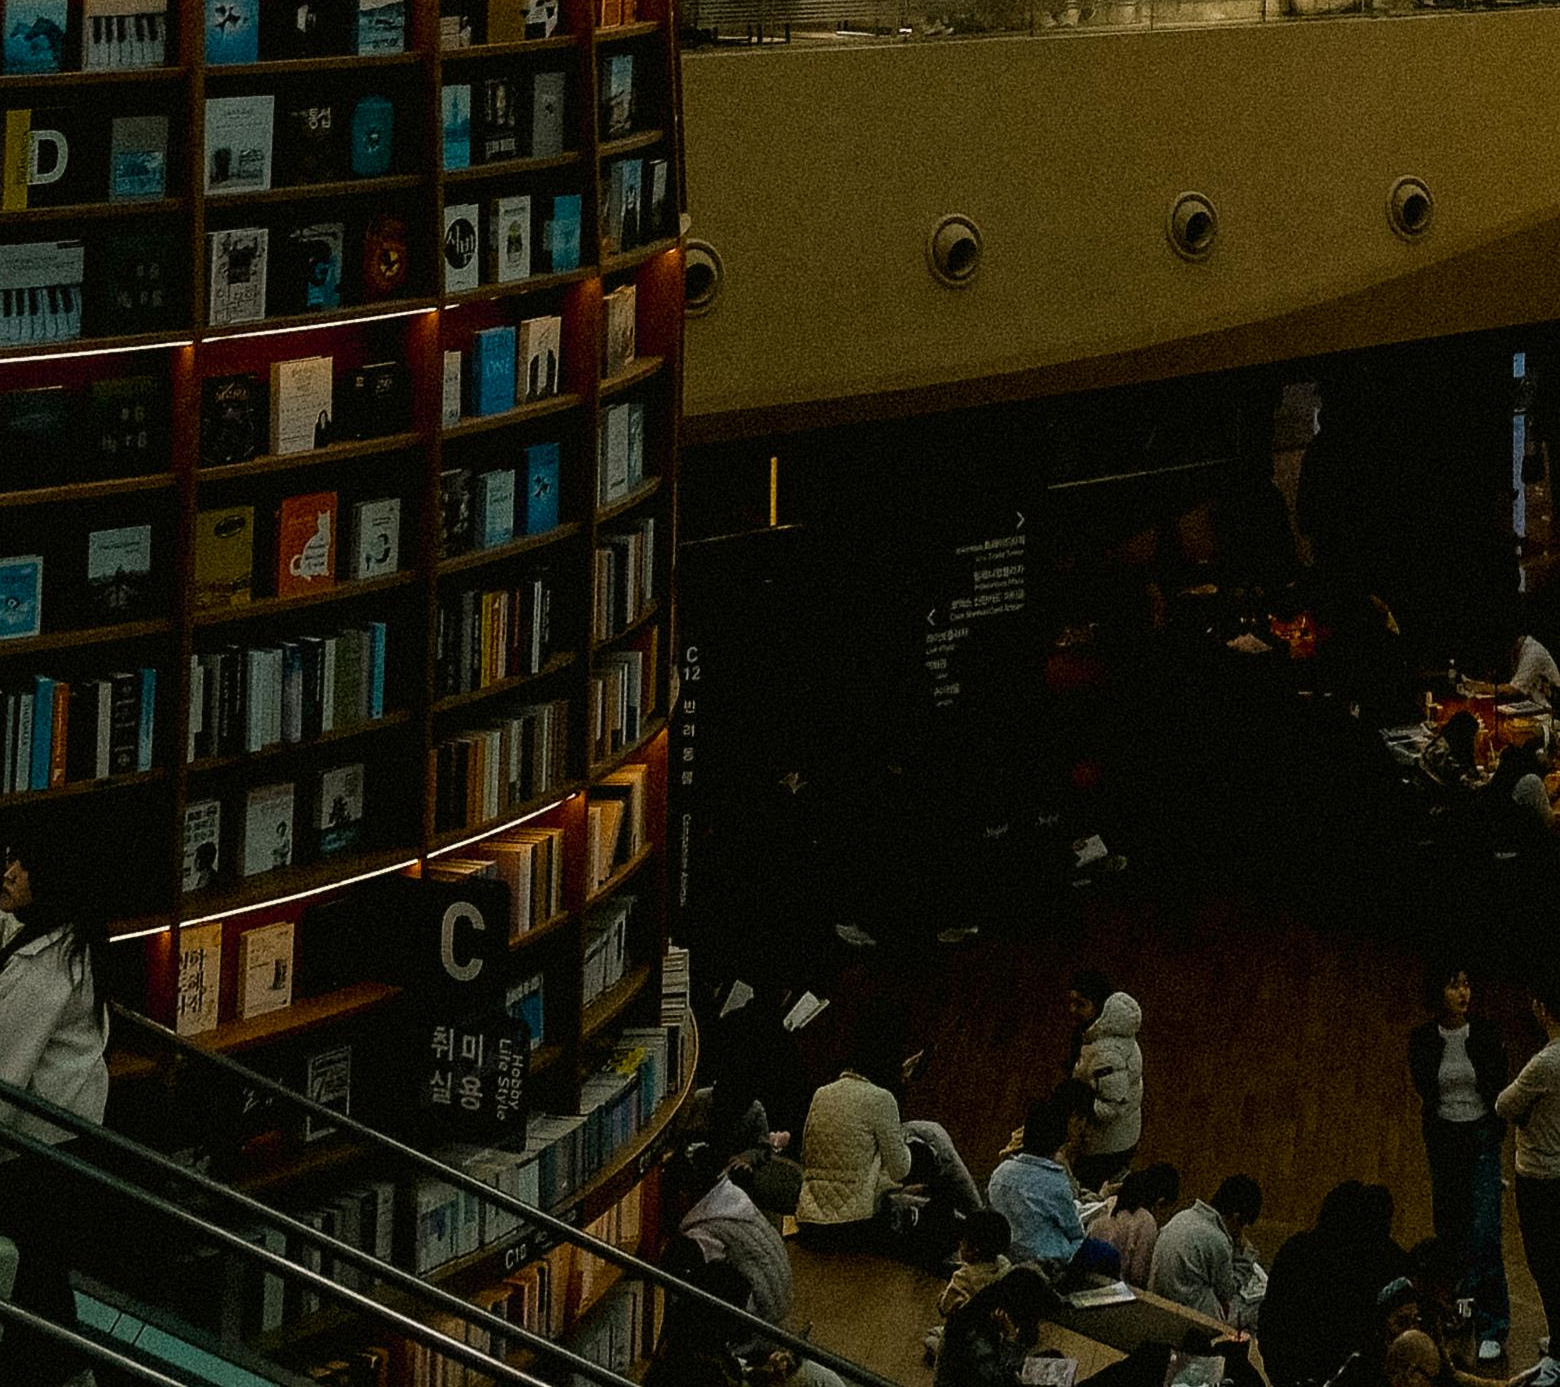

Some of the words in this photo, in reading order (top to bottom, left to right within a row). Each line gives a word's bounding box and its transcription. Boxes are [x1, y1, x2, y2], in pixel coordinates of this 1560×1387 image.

[27, 129, 69, 186] D
[683, 665, 701, 681] 12
[686, 646, 699, 663] C
[441, 901, 486, 981] C
[430, 1025, 484, 1068] 취미
[498, 1038, 513, 1073] Life
[429, 1069, 484, 1111] 실용
[495, 1076, 510, 1121] Style
[508, 1053, 524, 1111] Hobby
